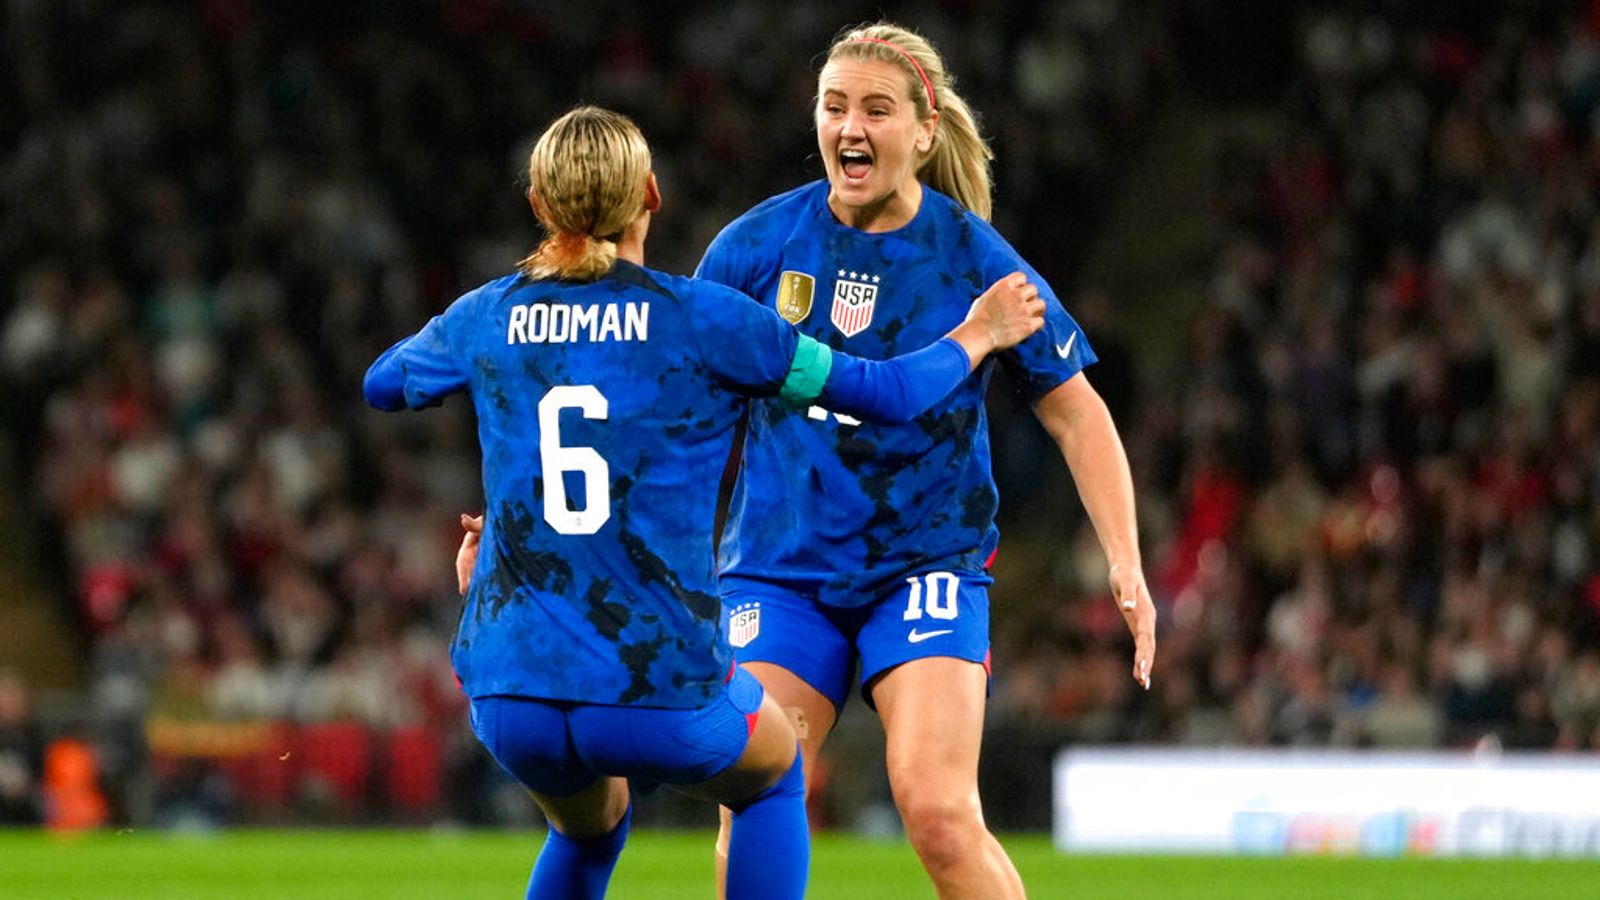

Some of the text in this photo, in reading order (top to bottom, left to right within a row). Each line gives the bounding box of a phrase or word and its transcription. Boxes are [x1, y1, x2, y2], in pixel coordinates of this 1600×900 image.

[838, 283, 874, 305] USA
[507, 301, 650, 345] RODMAN
[538, 384, 611, 535] 6
[903, 571, 960, 621] 10
